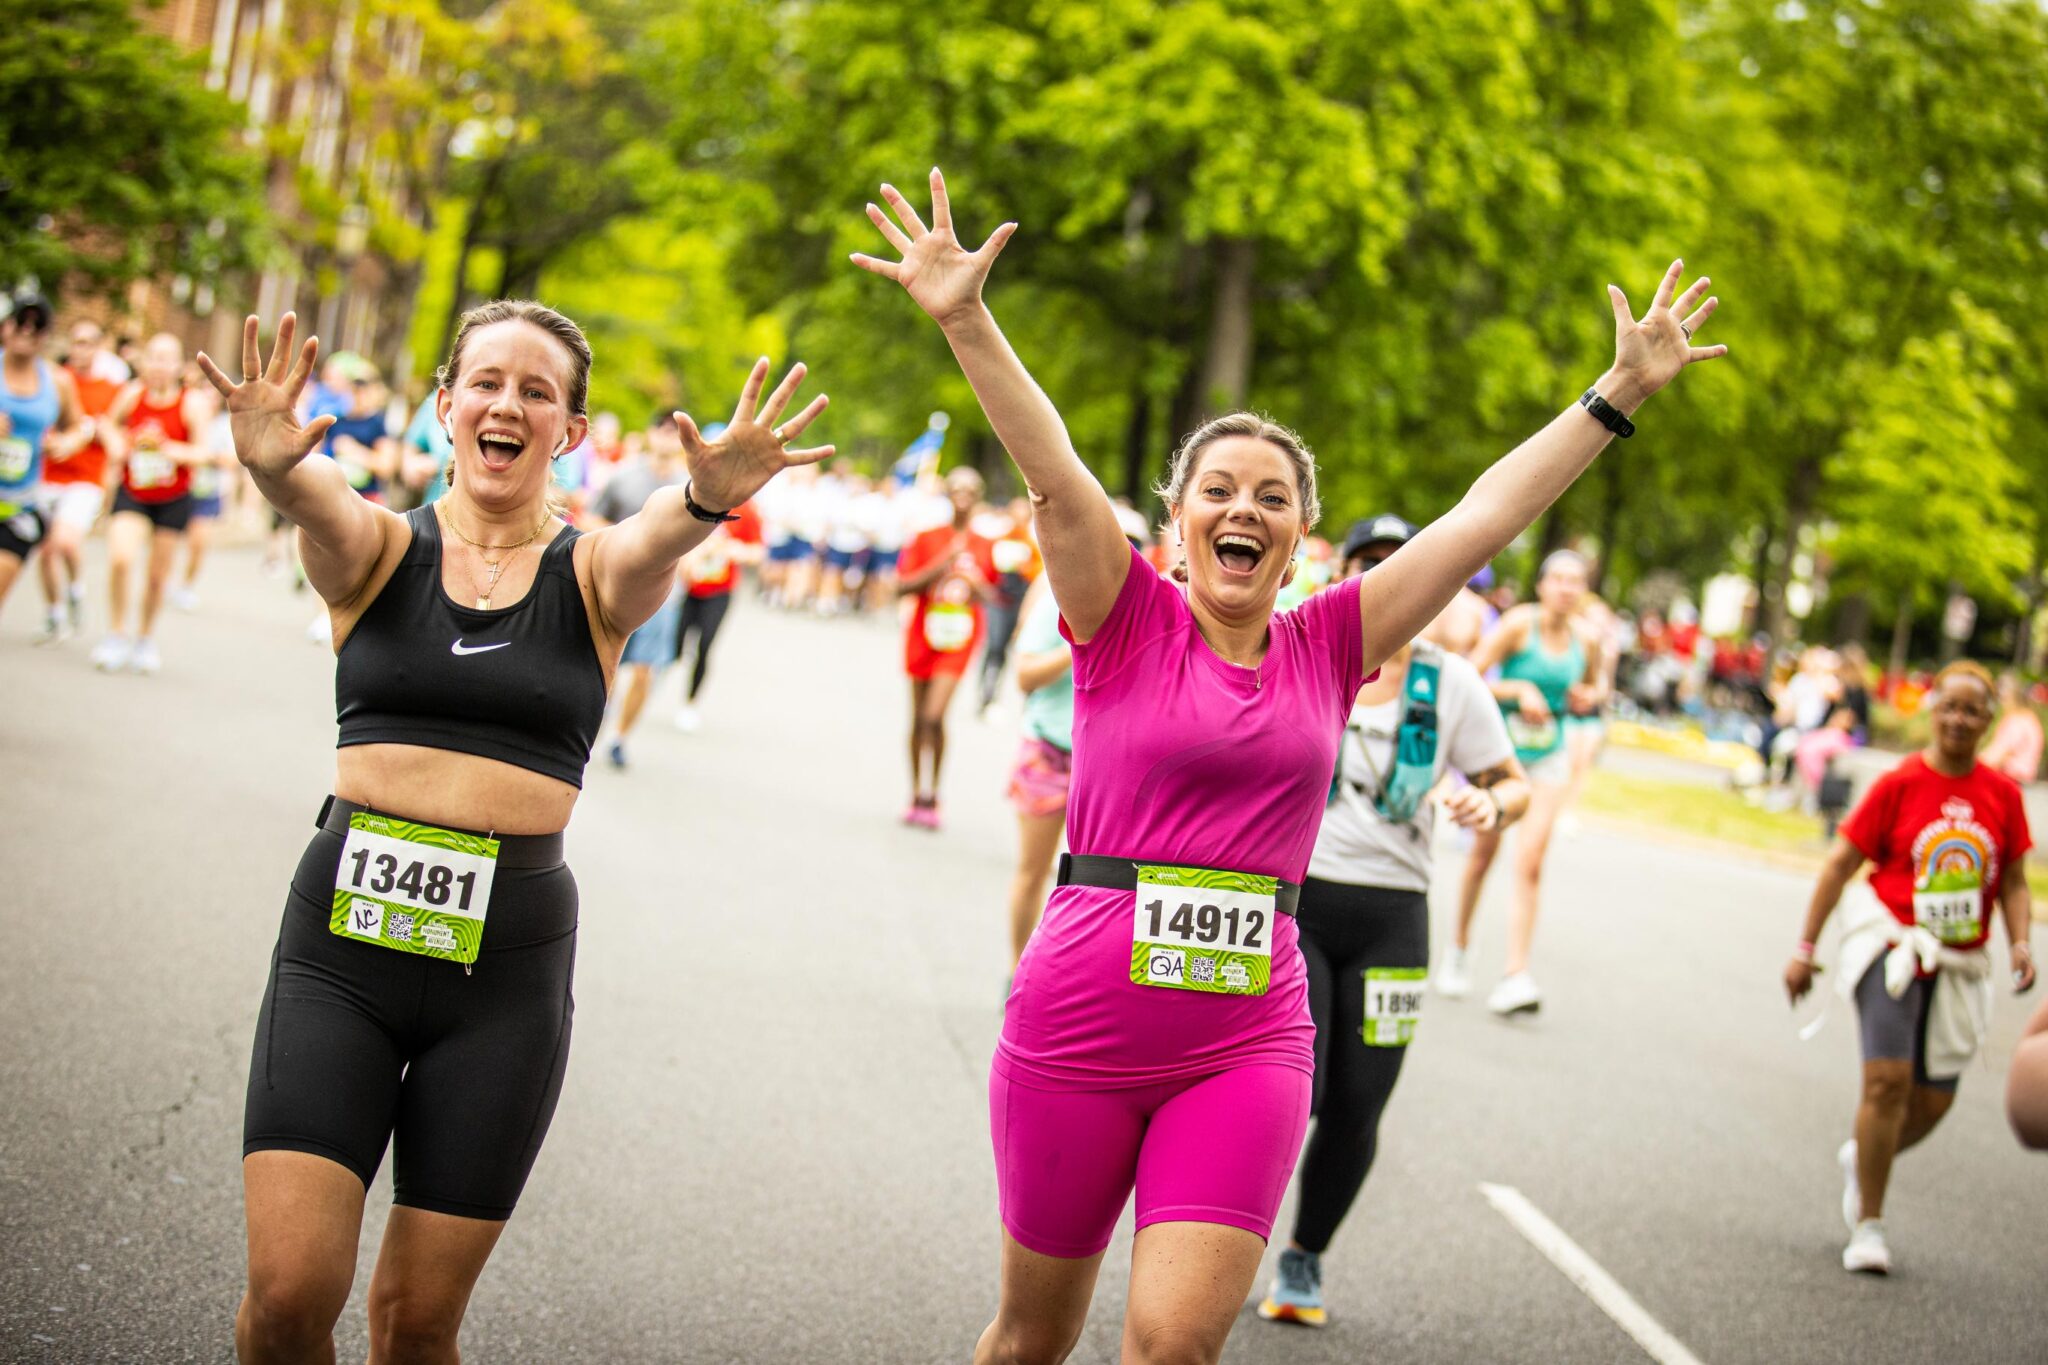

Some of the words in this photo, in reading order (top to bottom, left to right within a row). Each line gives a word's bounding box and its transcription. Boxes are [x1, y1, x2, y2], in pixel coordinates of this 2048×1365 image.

[351, 848, 476, 911] 13481
[355, 909, 379, 930] NC
[1145, 899, 1265, 948] 14912
[1150, 956, 1183, 977] QA
